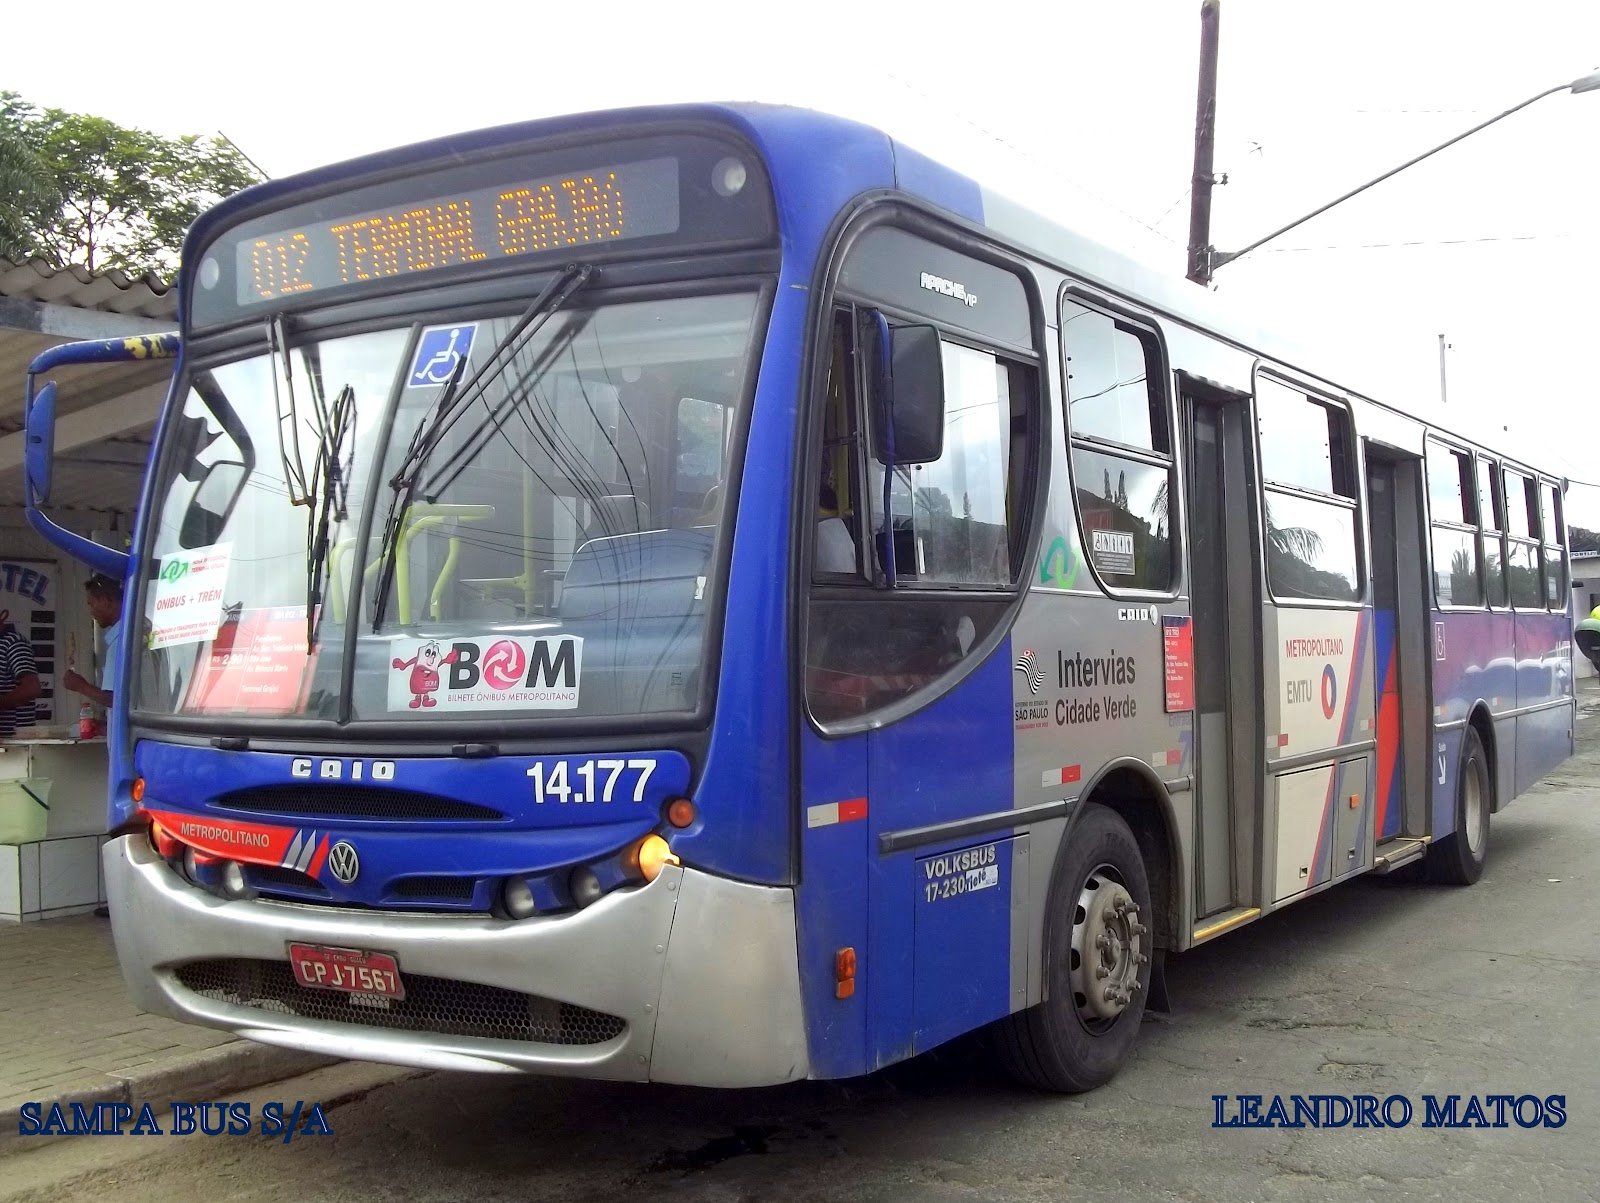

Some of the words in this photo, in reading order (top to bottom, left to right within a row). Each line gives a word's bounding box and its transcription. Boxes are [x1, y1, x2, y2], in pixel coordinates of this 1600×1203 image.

[252, 233, 313, 297] 012
[330, 199, 487, 283] TERMINAL
[920, 271, 965, 301] APACHE
[963, 292, 978, 307] VIP
[0, 563, 48, 606] TEL
[1118, 608, 1148, 621] CAIO
[1286, 639, 1344, 658] METROPOLITANO
[448, 639, 577, 690] BOM
[1057, 649, 1136, 689] Intervias
[447, 694, 474, 702] BILHETE
[508, 692, 576, 701] METROPOLITANO
[1287, 680, 1312, 704] EMTU
[1015, 708, 1028, 721] SÃO
[1029, 707, 1049, 720] PAULO
[1055, 697, 1100, 726] Cidade
[1104, 695, 1136, 720] Verde
[291, 758, 395, 780] CAIO
[526, 759, 657, 804] 14.177
[180, 822, 270, 848] METROPOLITANO
[925, 844, 996, 880] VOLKSBUS
